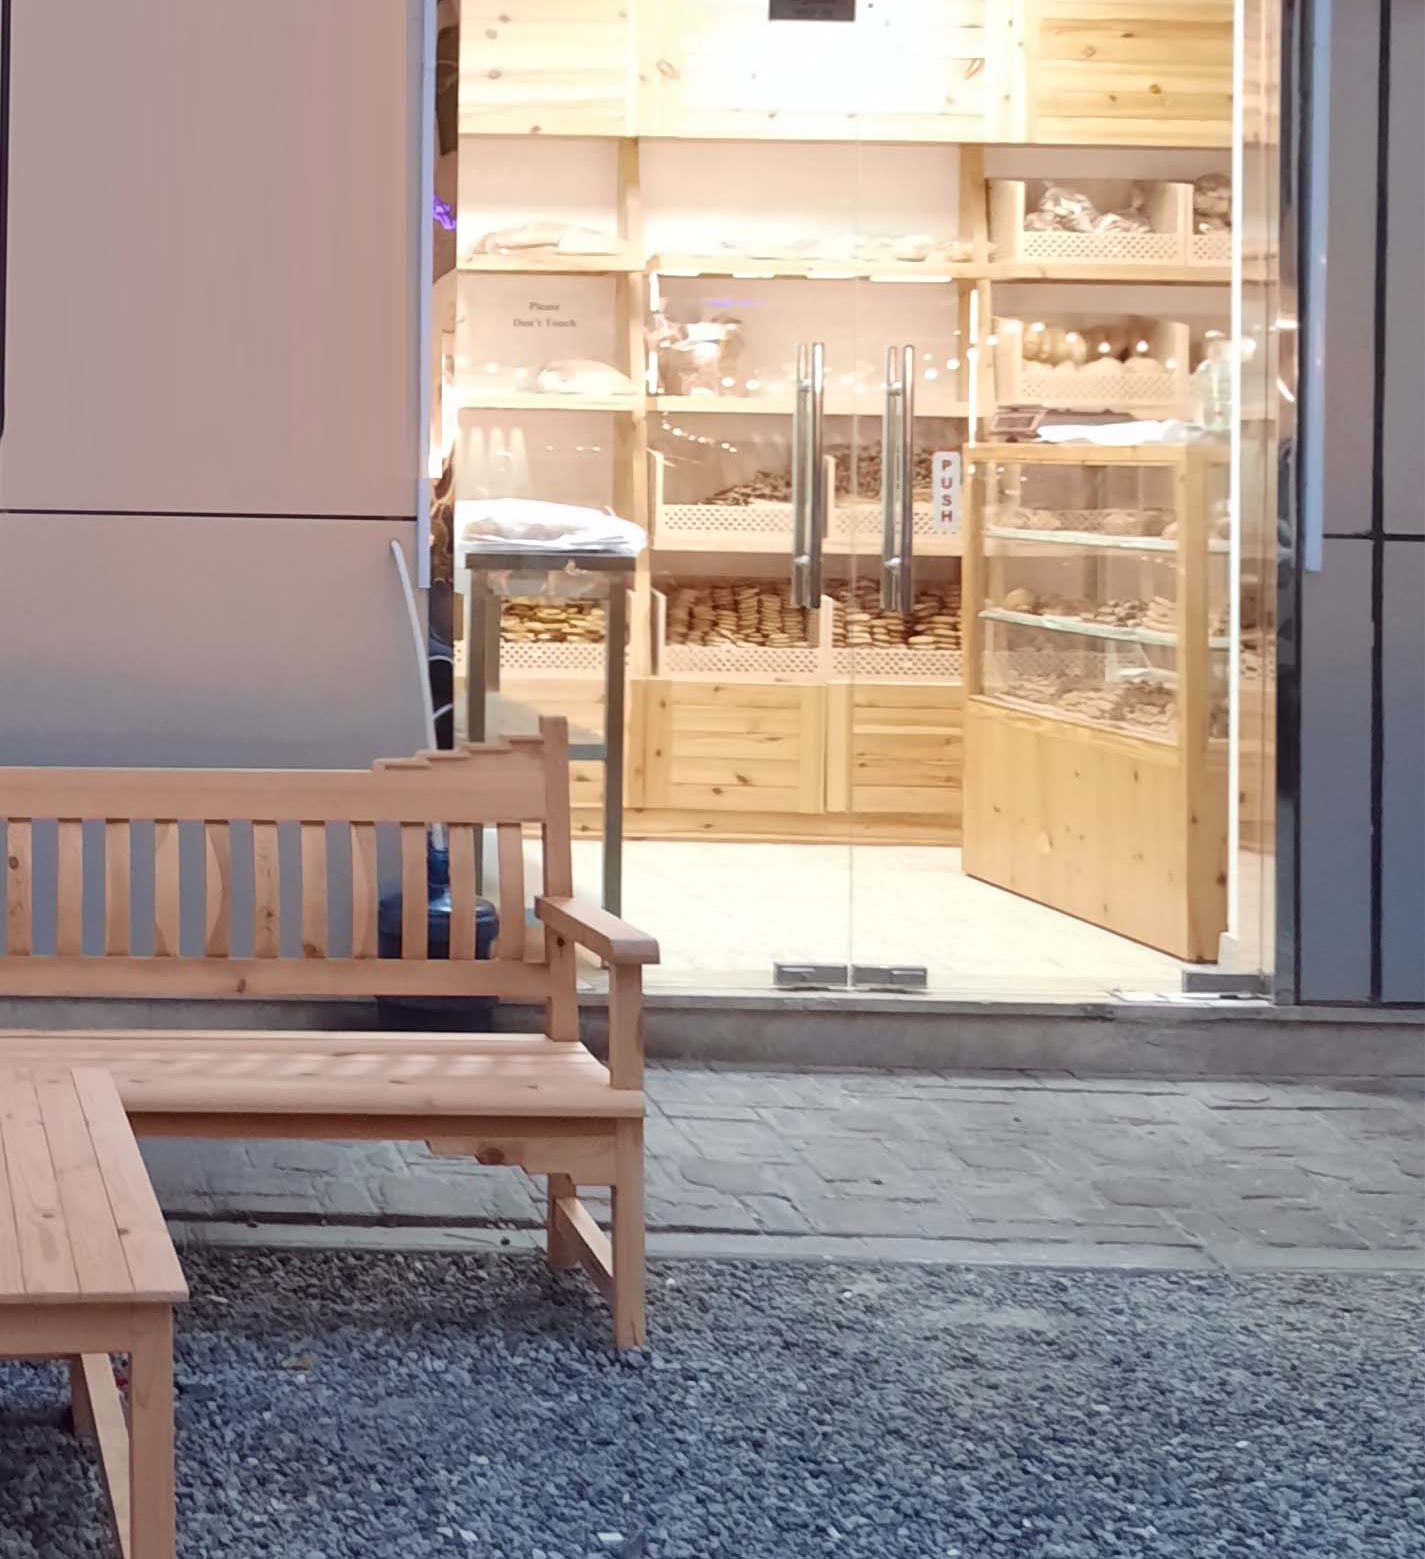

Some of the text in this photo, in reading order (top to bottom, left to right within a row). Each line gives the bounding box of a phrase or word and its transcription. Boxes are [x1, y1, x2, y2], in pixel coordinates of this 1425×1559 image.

[528, 301, 560, 311] Please
[545, 317, 577, 328] Touch
[941, 459, 953, 522] PUSH
